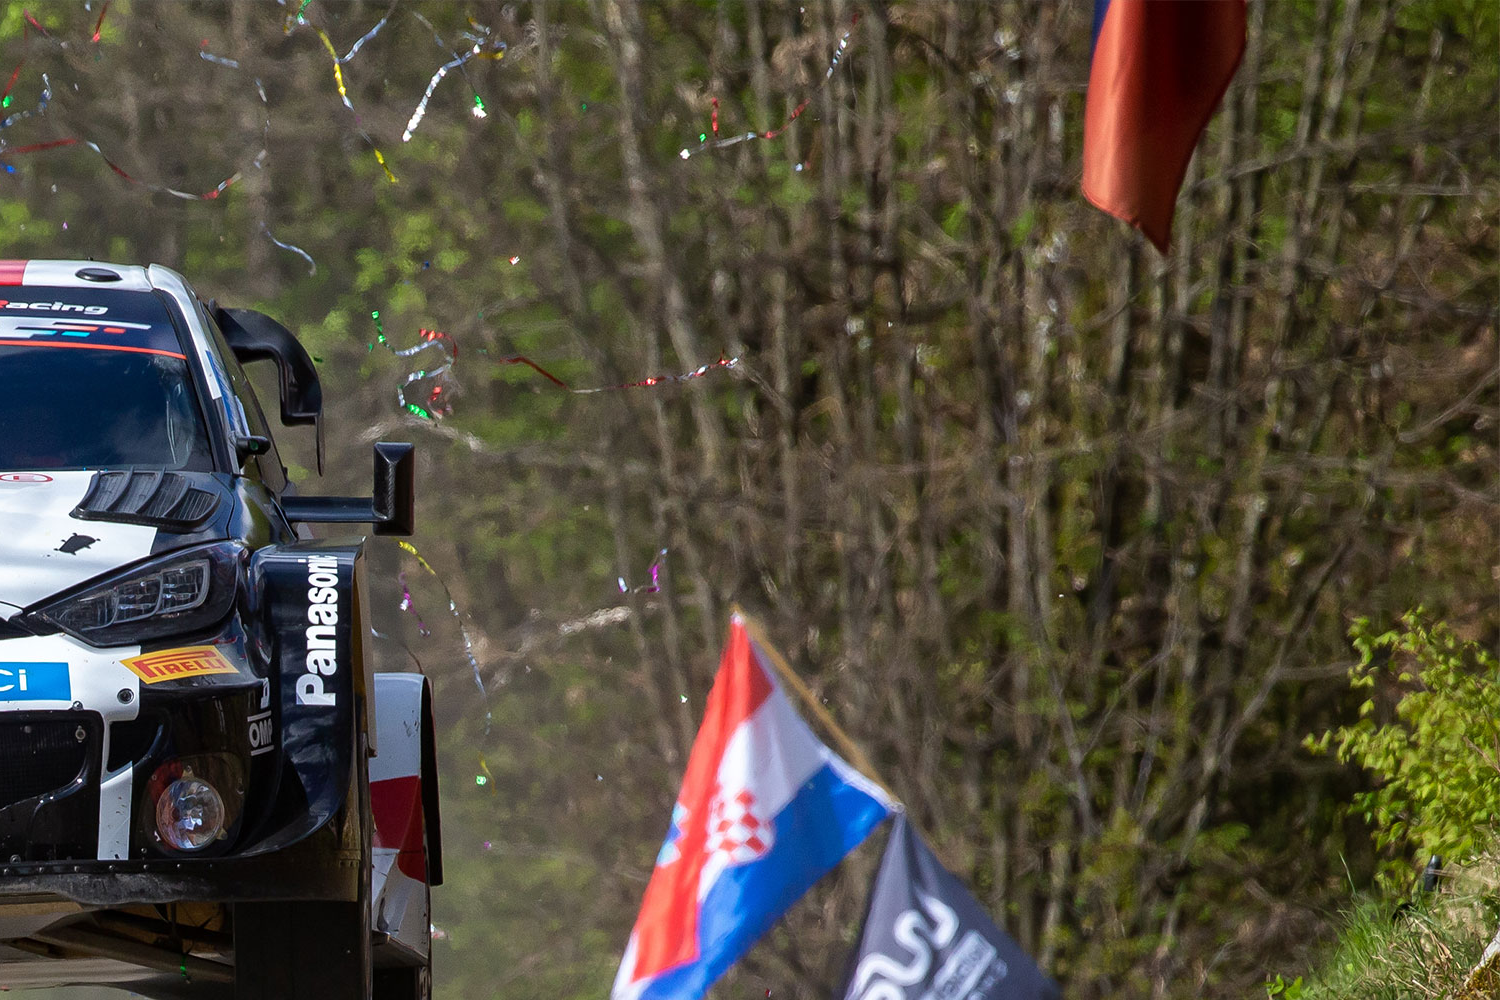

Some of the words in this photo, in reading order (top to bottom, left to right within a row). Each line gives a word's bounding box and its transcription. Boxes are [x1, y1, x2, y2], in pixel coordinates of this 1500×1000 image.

[296, 554, 340, 707] Panasonic
[131, 650, 228, 678] PIRELLI
[248, 717, 274, 748] OMP
